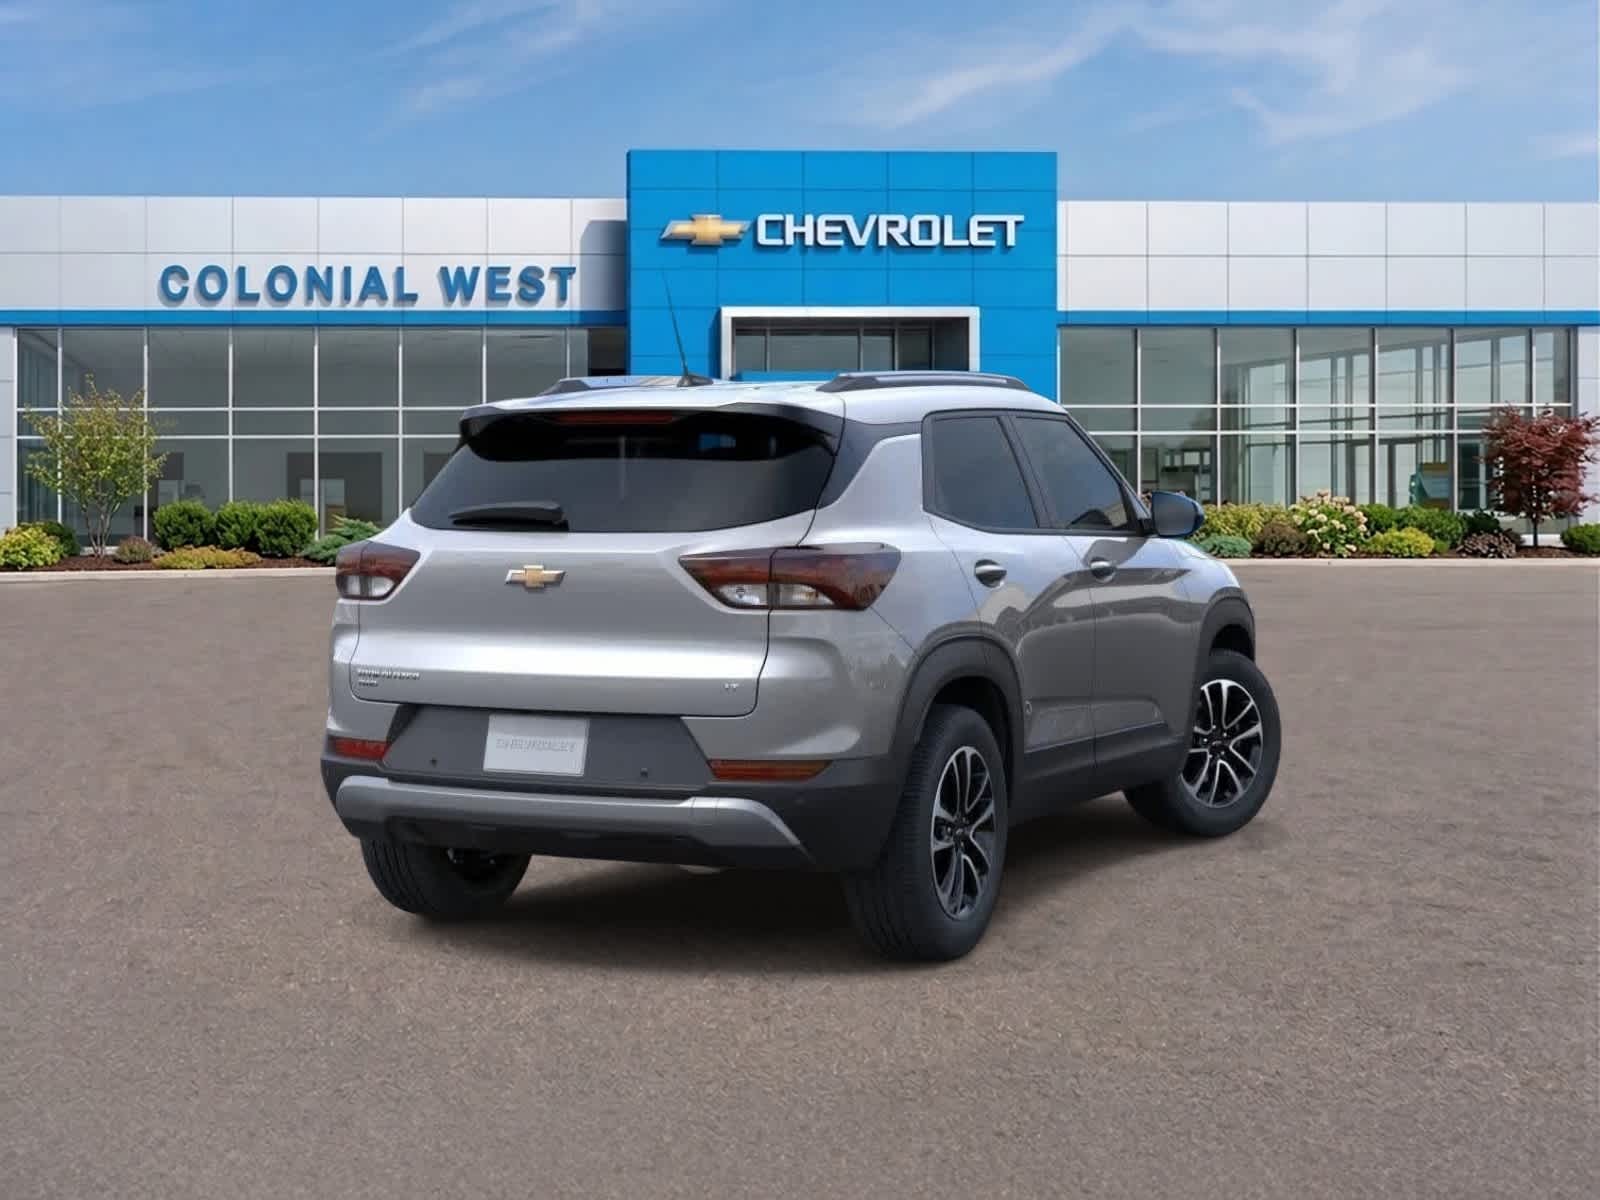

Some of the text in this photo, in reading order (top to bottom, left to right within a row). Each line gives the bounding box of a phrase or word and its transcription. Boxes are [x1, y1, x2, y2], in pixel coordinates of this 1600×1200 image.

[756, 213, 1025, 248] CHEVROLET
[159, 264, 577, 305] COLONIAL WEST
